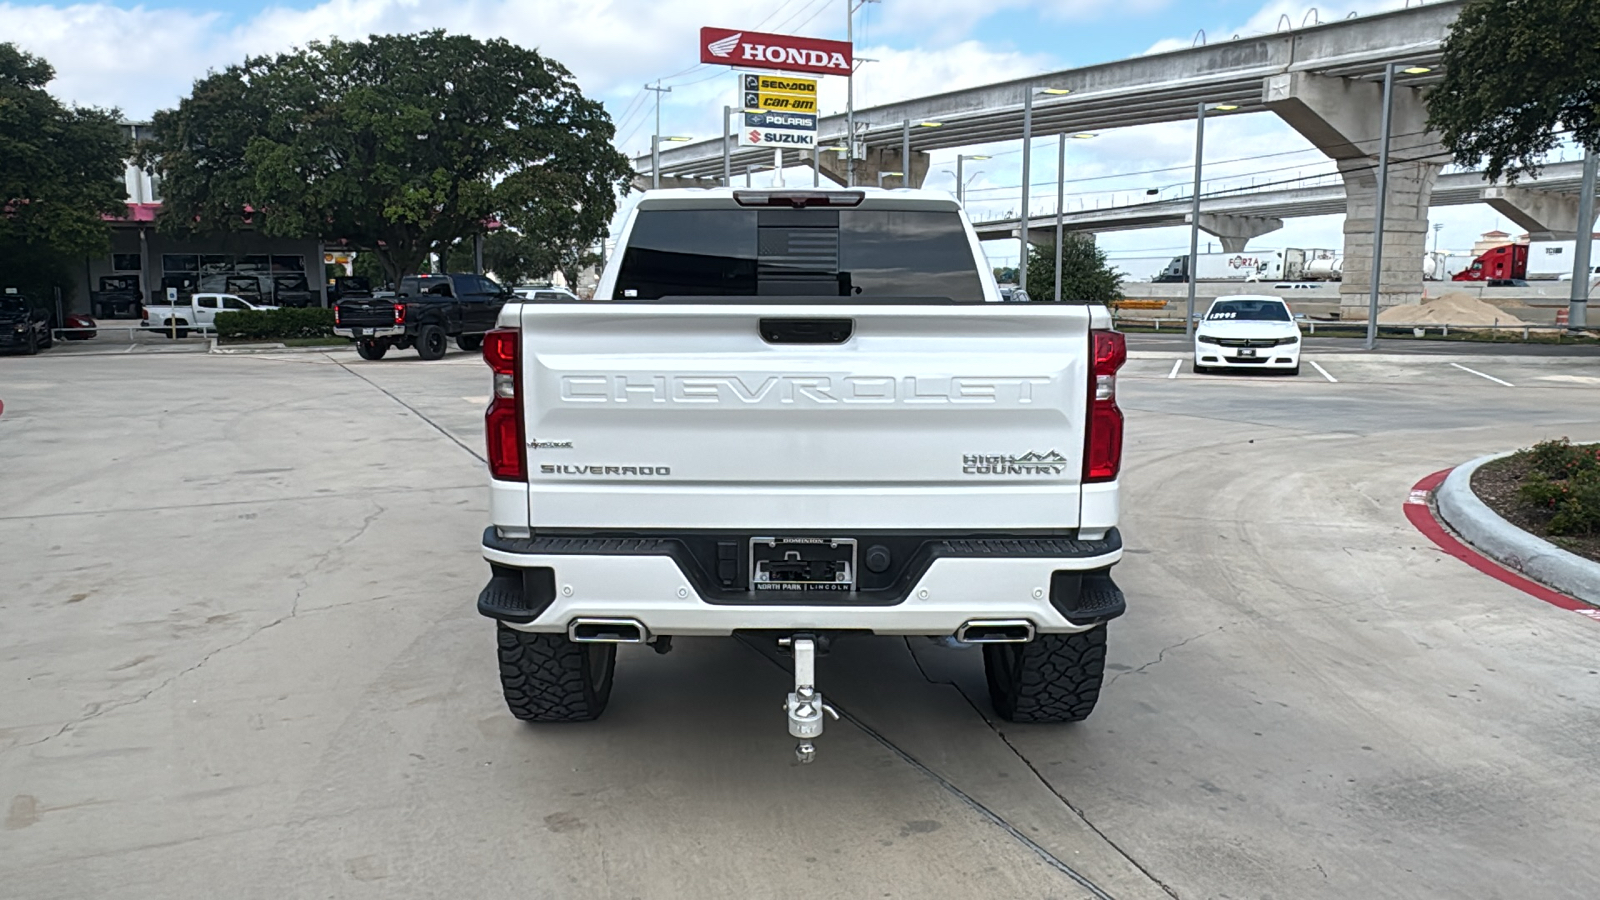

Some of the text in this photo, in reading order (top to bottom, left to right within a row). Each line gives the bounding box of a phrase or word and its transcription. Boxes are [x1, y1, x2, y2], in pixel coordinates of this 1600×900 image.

[741, 43, 850, 69] HONDA
[763, 97, 814, 109] can-am
[766, 116, 813, 126] POLARIS
[764, 132, 813, 144] SUZUKI
[1228, 255, 1259, 269] FORZA
[560, 374, 1051, 404] CHEVROLET
[962, 454, 1015, 464] HIGH
[540, 464, 671, 476] SILVERADO
[962, 464, 1067, 474] COUNTRY
[757, 583, 781, 591] NORTH
